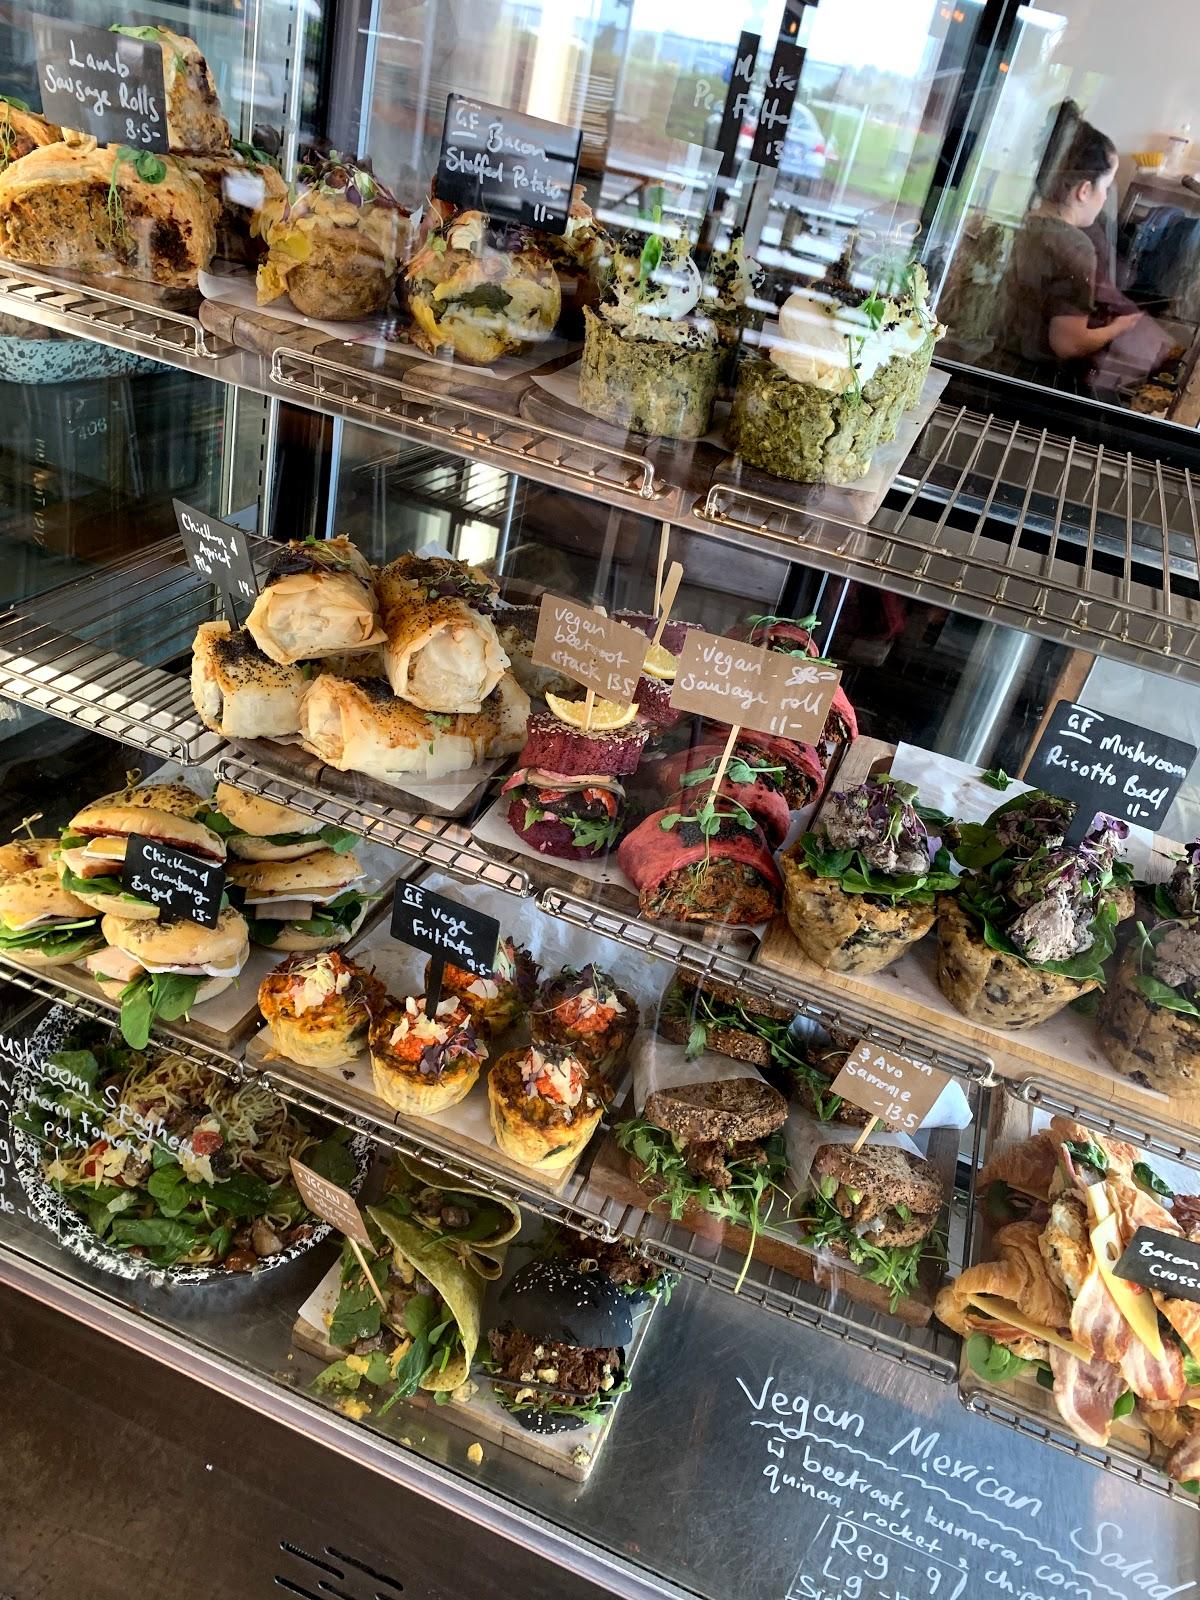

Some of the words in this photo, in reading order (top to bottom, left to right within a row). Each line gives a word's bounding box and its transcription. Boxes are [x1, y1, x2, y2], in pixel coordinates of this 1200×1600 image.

[69, 39, 130, 78] Lamb
[45, 64, 111, 117] Sausage
[119, 82, 160, 122] Rolls
[455, 107, 479, 130] GF
[487, 122, 549, 162] Bacon
[445, 146, 503, 184] Stuffed
[512, 165, 562, 200] Potato
[181, 513, 227, 549] Chicken
[199, 541, 231, 569] Apricot
[780, 692, 824, 715] roll
[1067, 713, 1094, 734] GF
[1099, 734, 1187, 779] Mushroom
[1046, 745, 1117, 786] Risotto
[1122, 774, 1169, 811] Ball
[142, 845, 198, 877] Chicken
[131, 875, 173, 905] Bagel
[151, 867, 210, 905] Cranberry
[404, 888, 423, 904] GF
[412, 919, 474, 956] Frittata
[0, 1034, 90, 1096] ushroom
[873, 1056, 904, 1078] Avo
[1139, 1241, 1199, 1270] Bacon
[736, 1376, 864, 1438] Vegan
[888, 1427, 1042, 1517] Mexican
[1070, 1521, 1197, 1600] Salad
[831, 1521, 889, 1580] Reg
[862, 1511, 943, 1553] rocket
[925, 1506, 1023, 1567] kumera,
